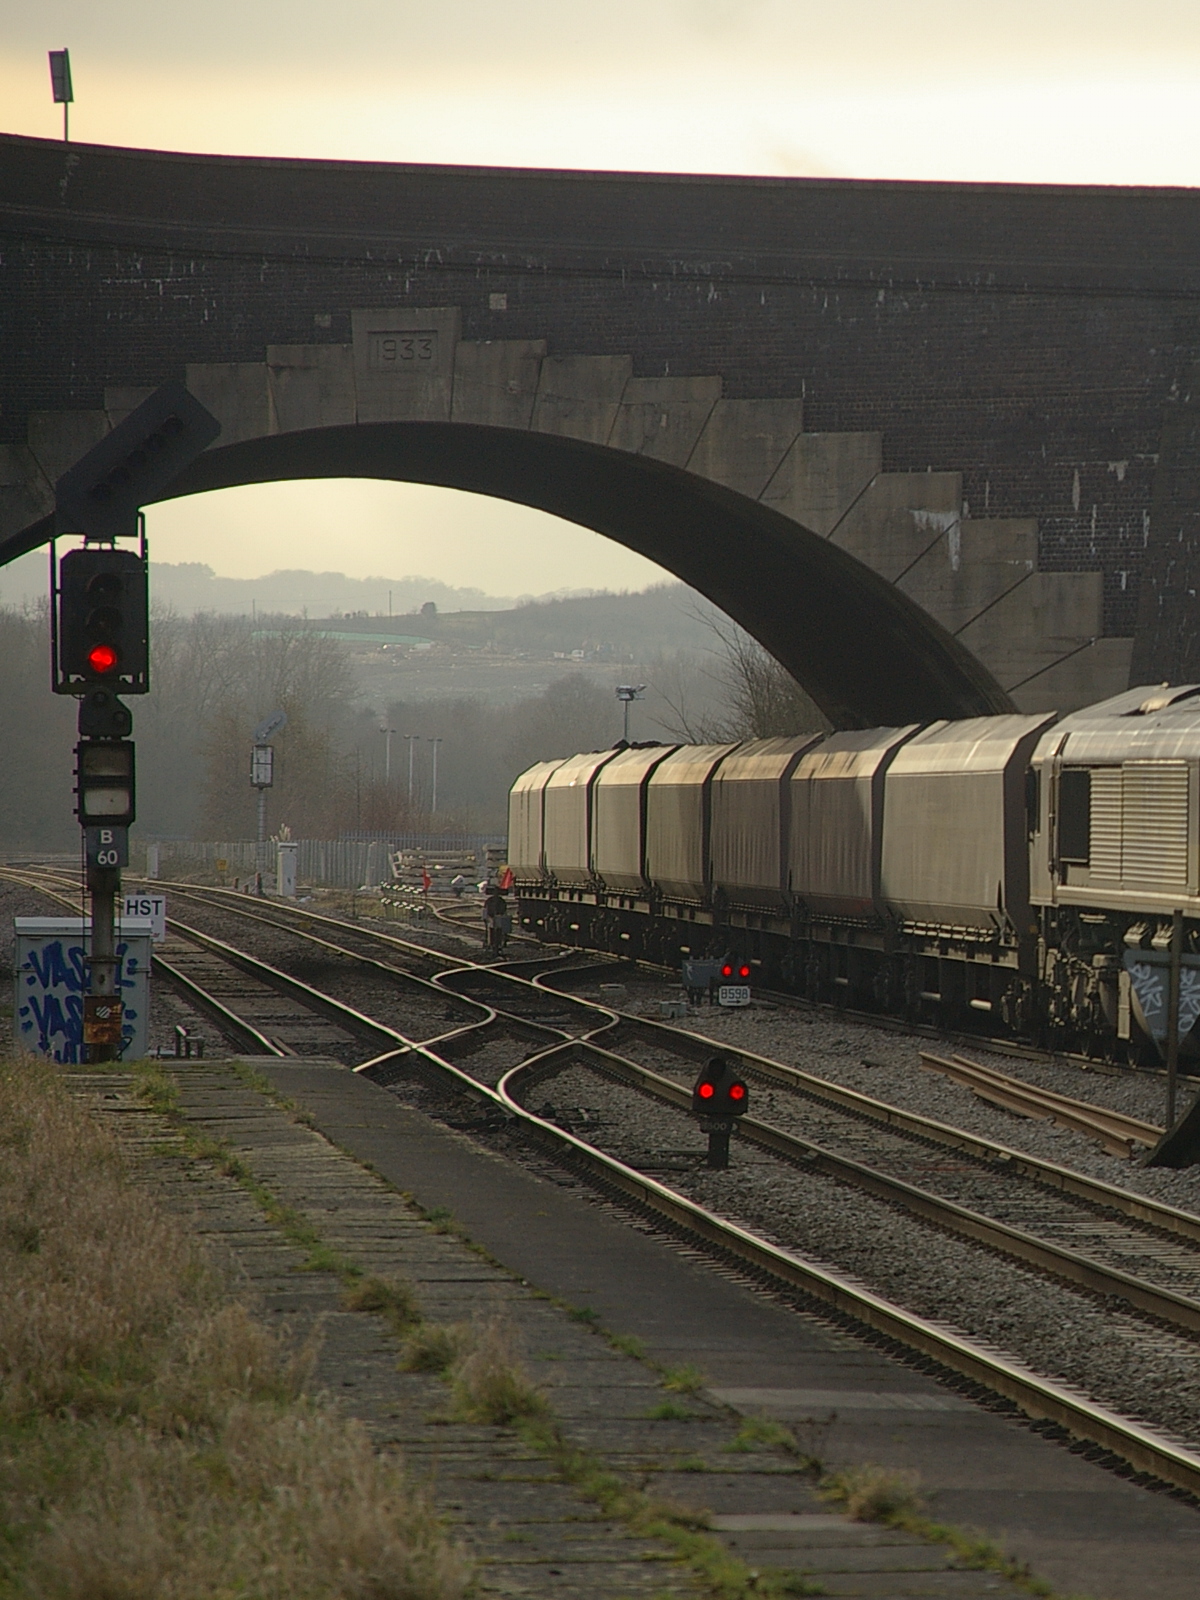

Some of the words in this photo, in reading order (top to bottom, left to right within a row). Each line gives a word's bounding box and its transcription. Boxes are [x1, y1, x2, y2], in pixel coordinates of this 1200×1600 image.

[376, 338, 432, 360] 1933
[100, 830, 113, 844] B
[97, 850, 118, 865] 60
[126, 899, 163, 915] HST
[721, 988, 748, 999] 8598
